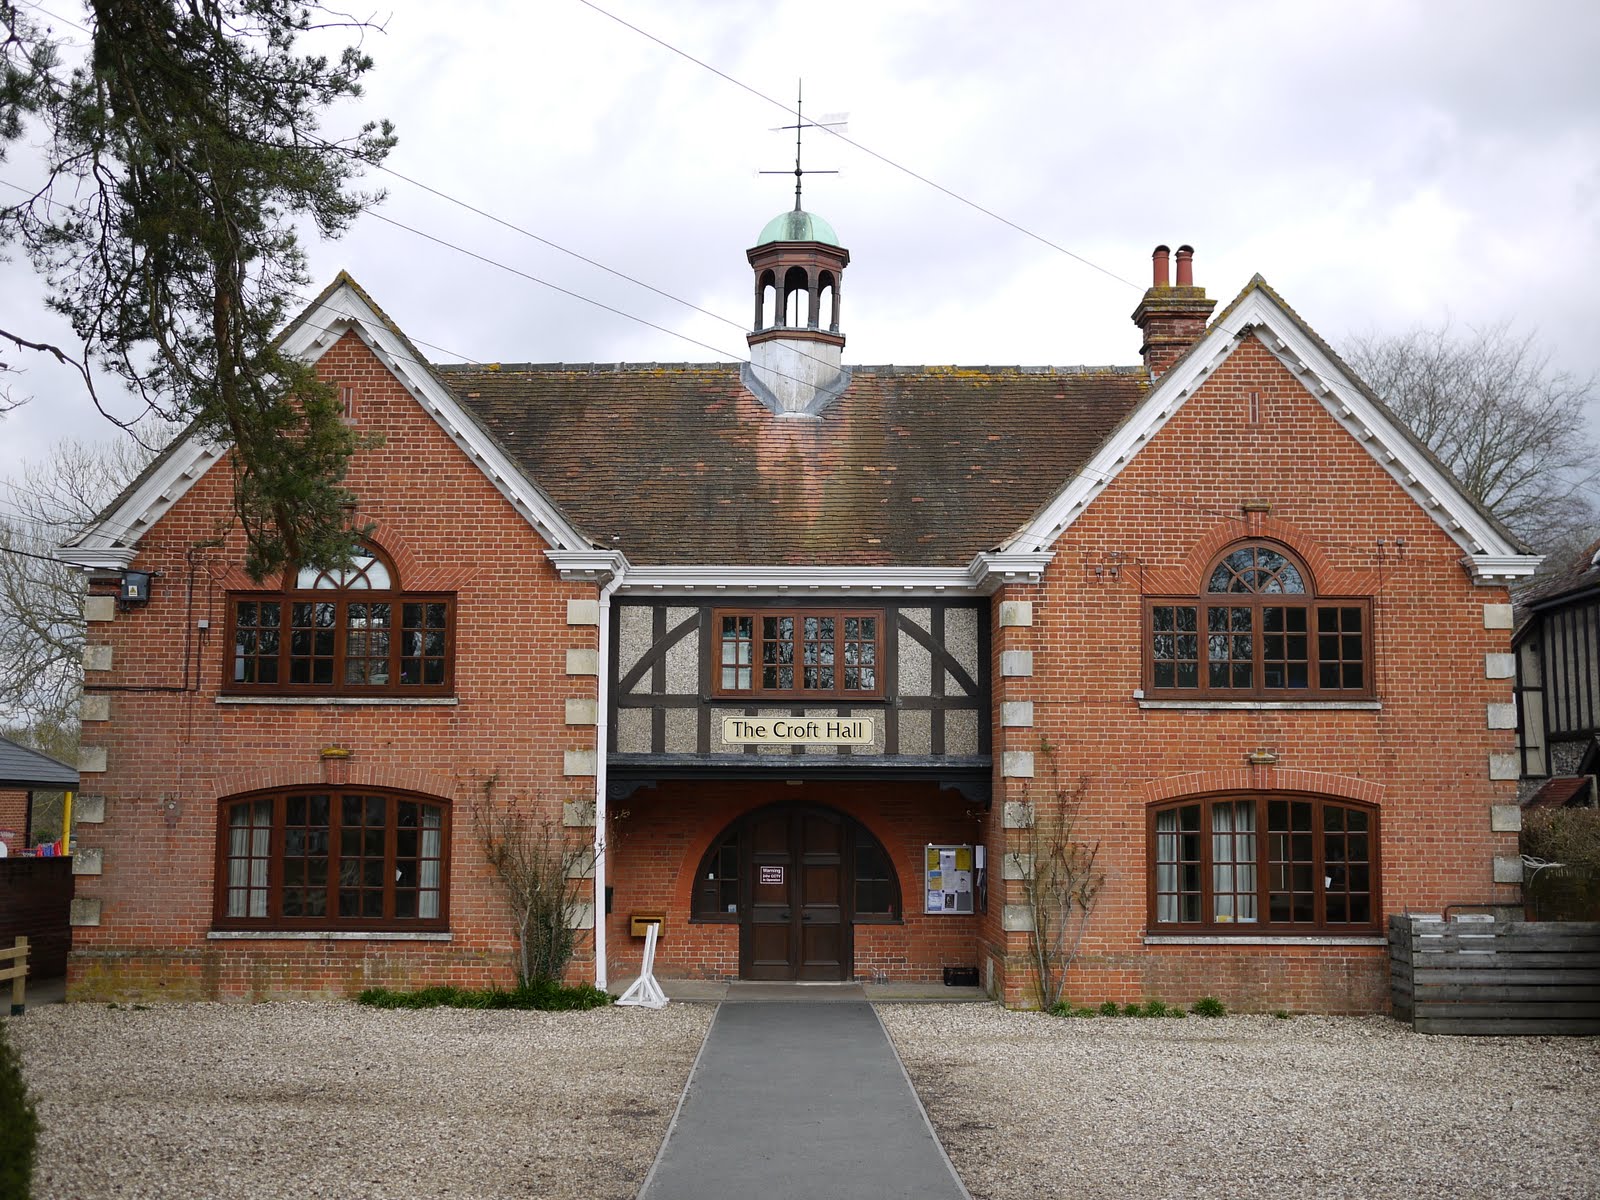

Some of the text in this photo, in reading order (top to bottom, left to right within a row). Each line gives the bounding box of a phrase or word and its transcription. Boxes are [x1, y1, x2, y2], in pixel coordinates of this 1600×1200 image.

[732, 721, 862, 738] The Croft Hall
